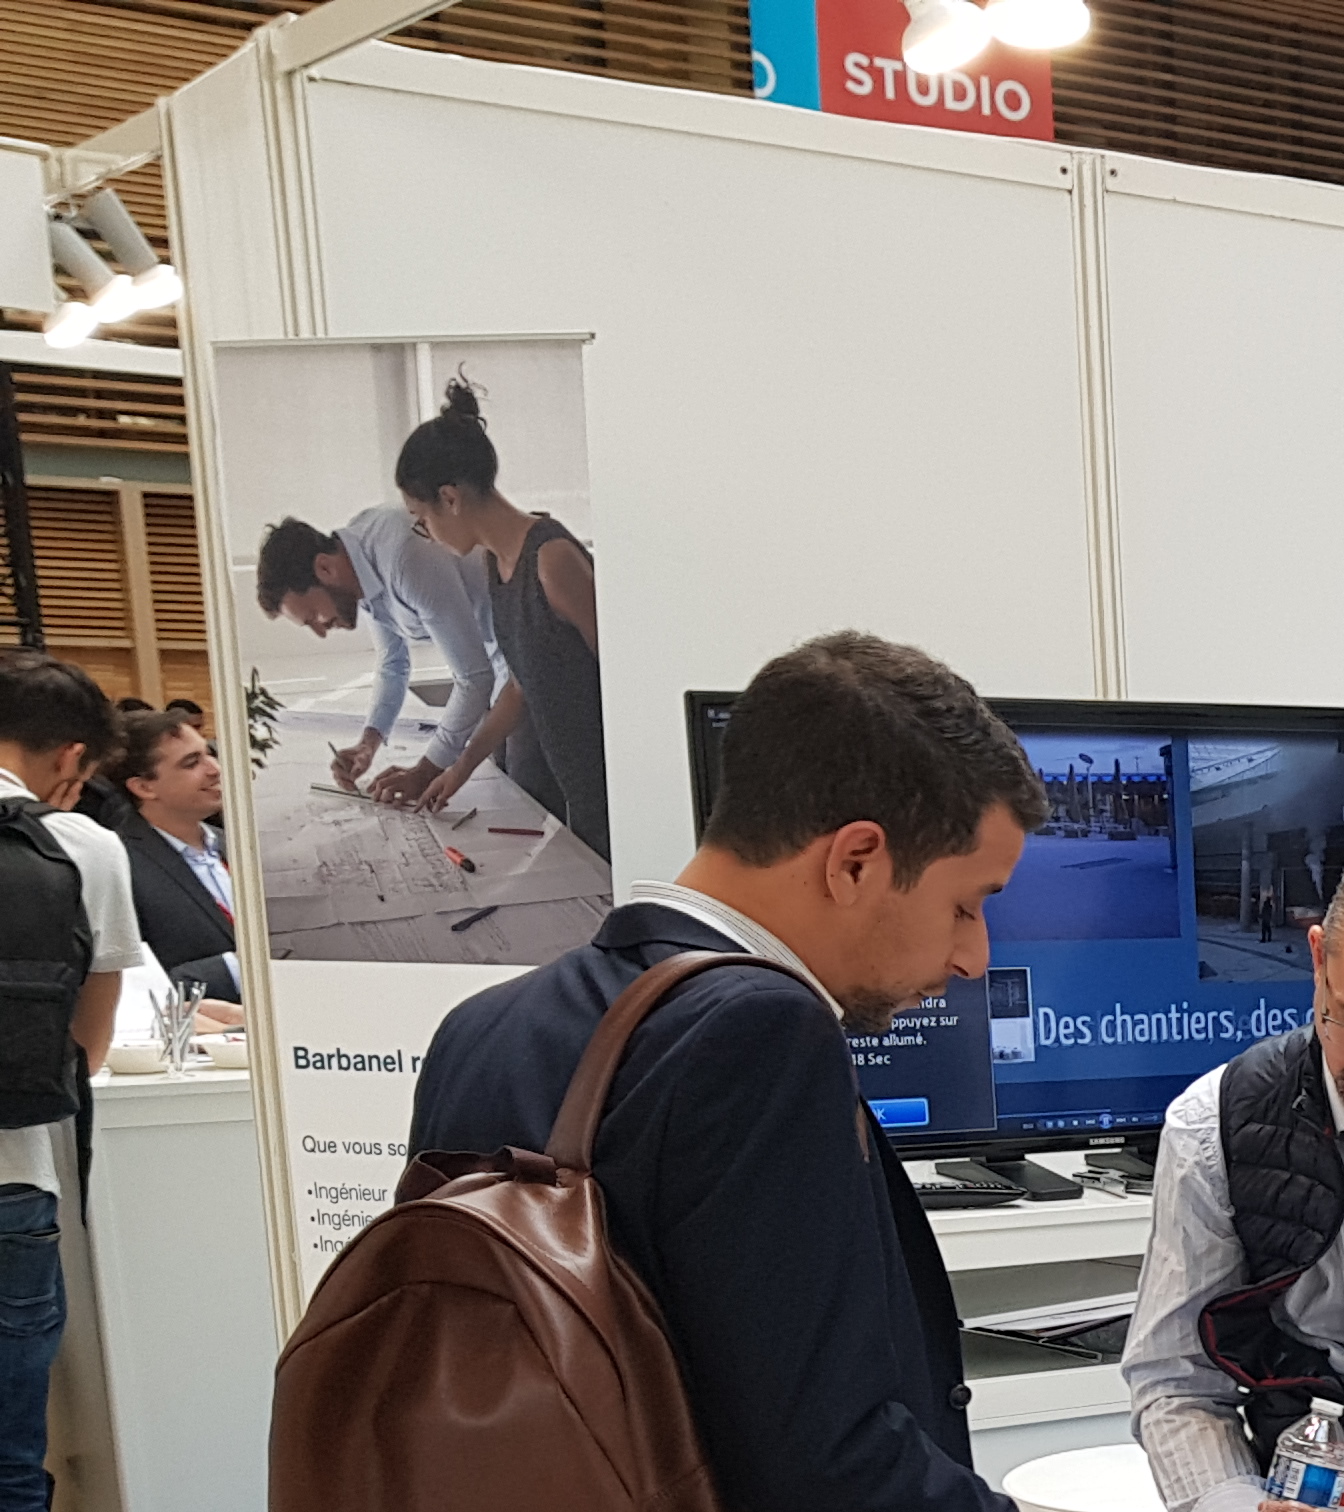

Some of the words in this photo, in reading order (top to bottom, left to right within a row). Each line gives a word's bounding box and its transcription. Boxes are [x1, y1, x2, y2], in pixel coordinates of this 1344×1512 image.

[844, 52, 1031, 121] STUDIO
[891, 1016, 937, 1030] ppuyez
[940, 1016, 959, 1026] sur
[1038, 1006, 1091, 1046] Des
[1100, 1000, 1242, 1044] chantiers,
[1251, 997, 1298, 1037] des
[293, 1046, 403, 1073] Barbanel
[868, 1053, 891, 1065] Sec
[302, 1135, 337, 1155] Que
[342, 1141, 383, 1156] vous
[388, 1142, 407, 1157] so
[314, 1182, 388, 1203] Ingénieur
[317, 1209, 375, 1230] Ingénie
